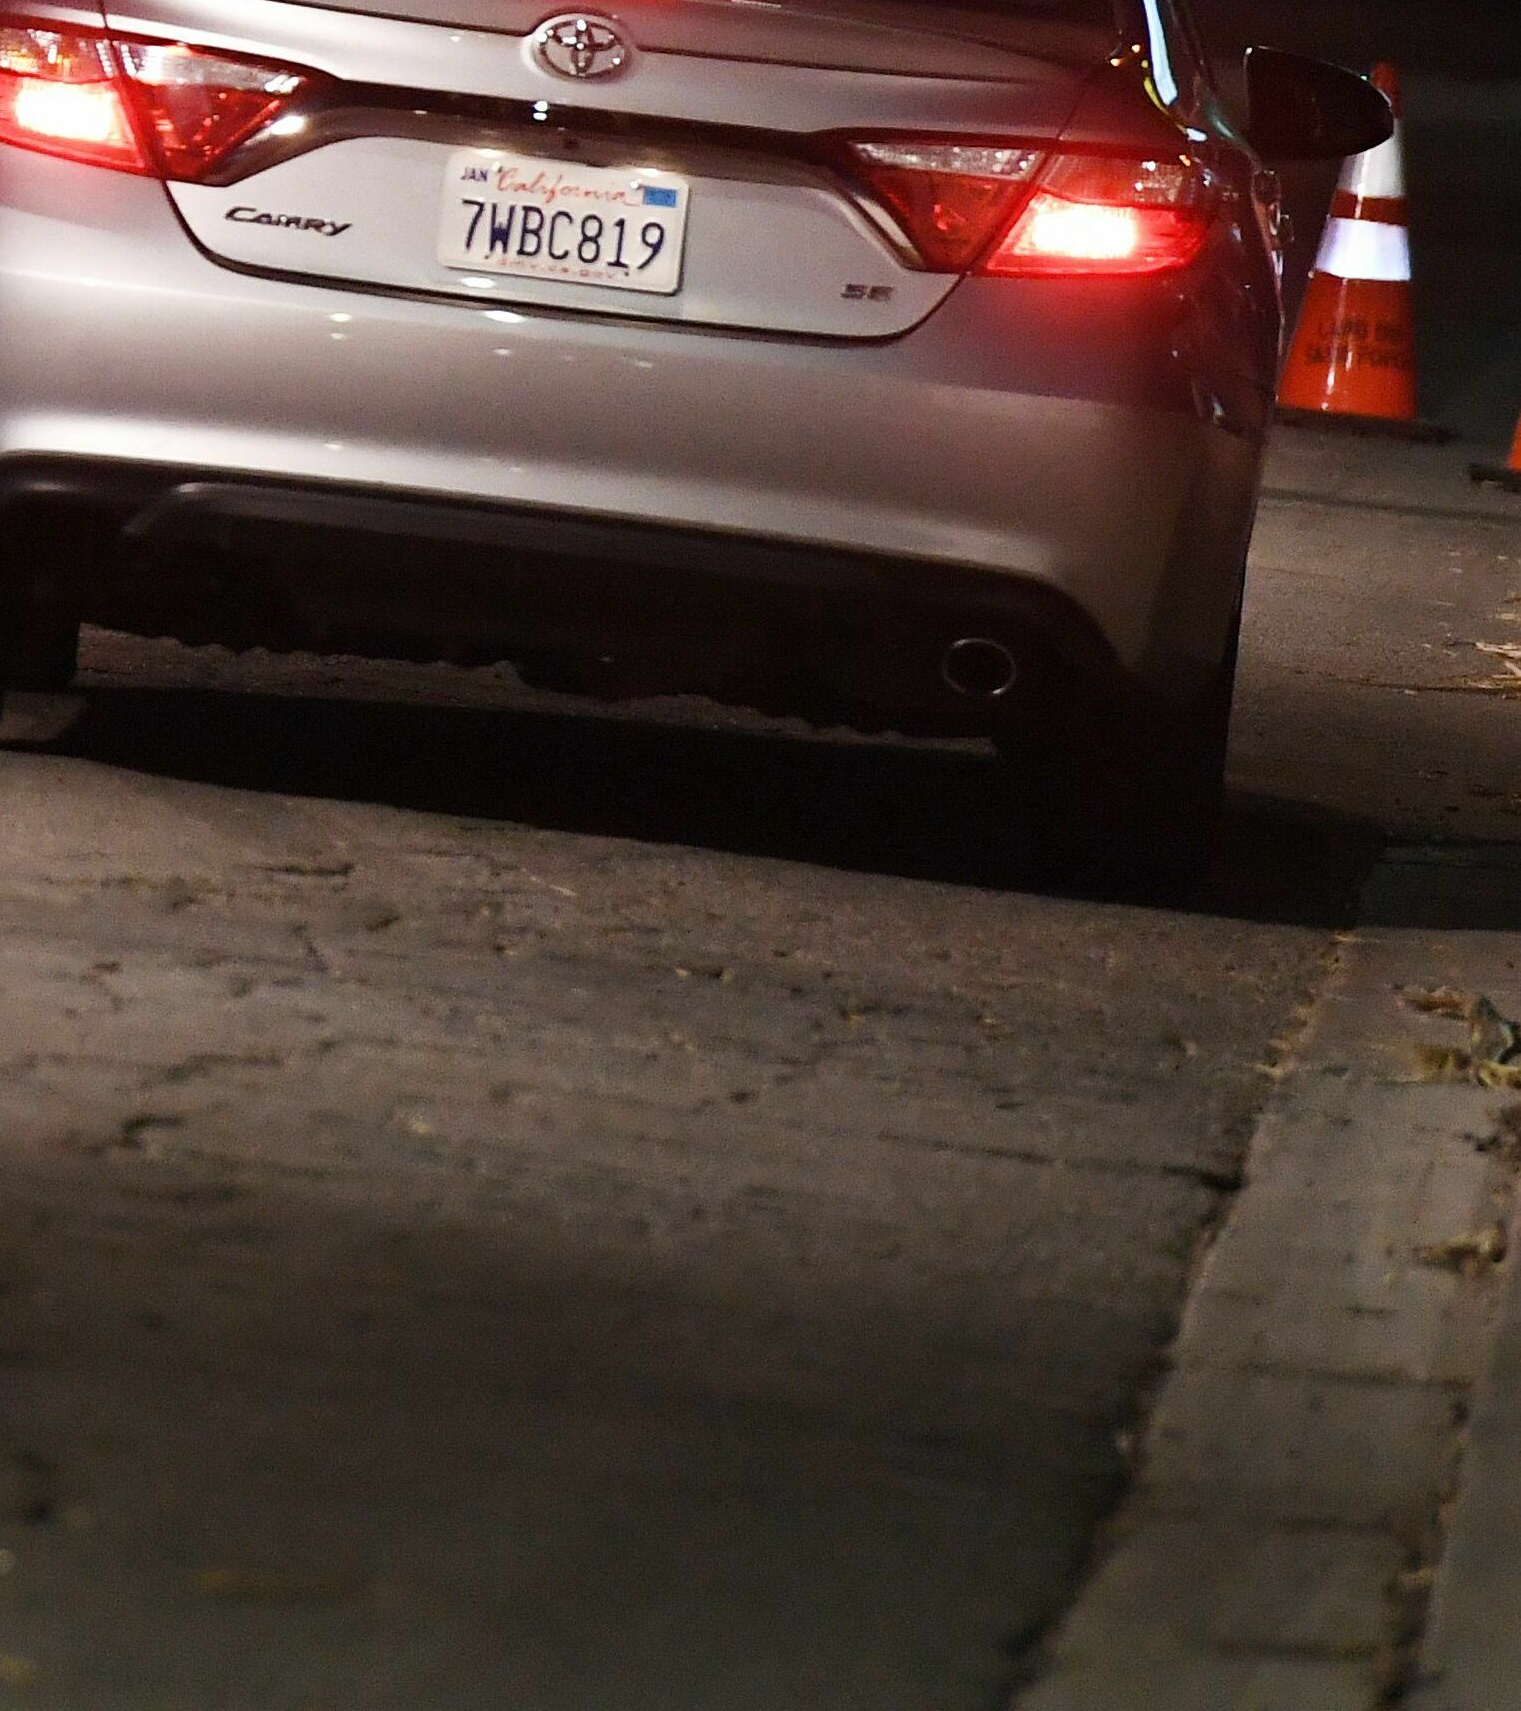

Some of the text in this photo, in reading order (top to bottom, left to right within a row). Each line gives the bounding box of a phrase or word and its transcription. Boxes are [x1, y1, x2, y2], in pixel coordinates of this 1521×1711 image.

[460, 166, 488, 182] JAN
[497, 168, 641, 208] California
[462, 199, 665, 270] 7WBC819
[840, 284, 895, 302] SE
